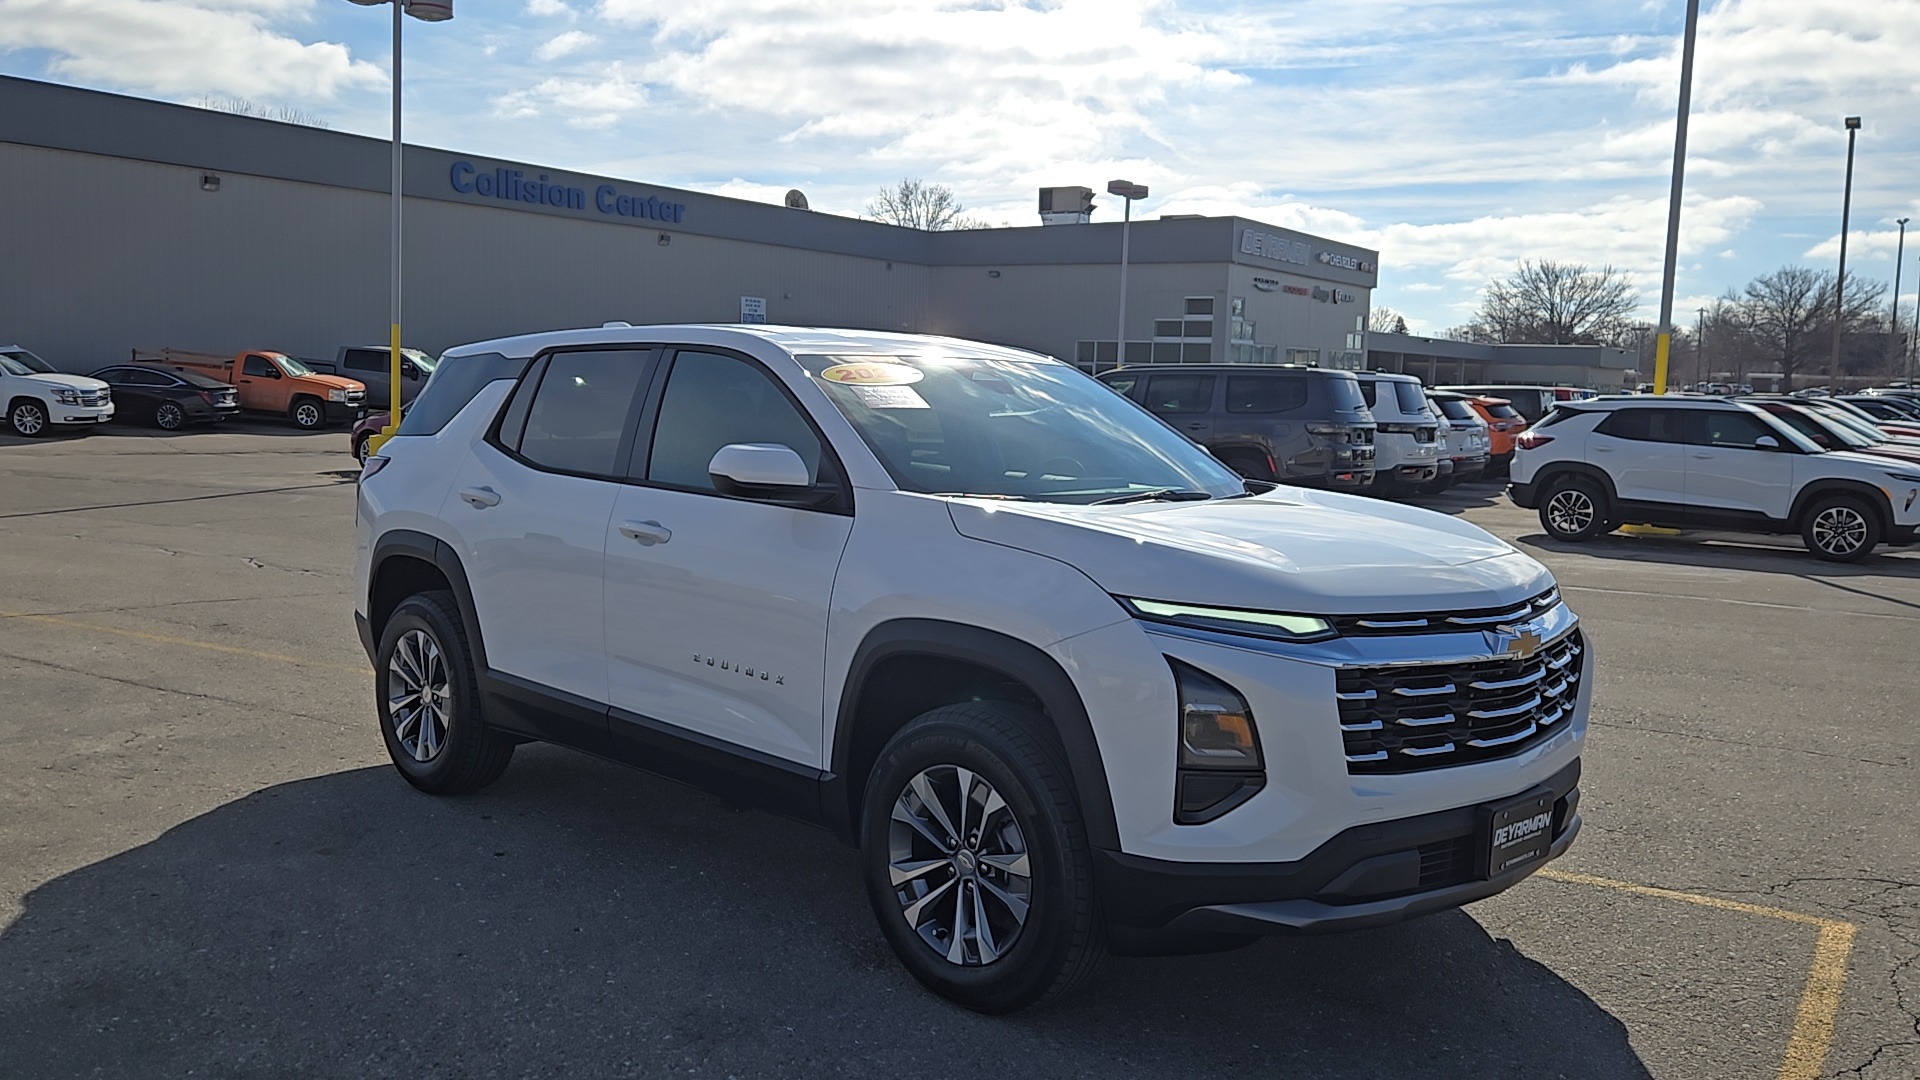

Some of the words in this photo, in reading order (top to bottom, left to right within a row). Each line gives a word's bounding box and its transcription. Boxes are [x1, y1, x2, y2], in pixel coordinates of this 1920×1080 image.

[451, 161, 586, 210] Collision
[595, 184, 686, 224] Center
[1329, 253, 1358, 270] CHEVROLET
[693, 653, 784, 685] EQUINOX
[1494, 811, 1552, 847] DEYARMAN
